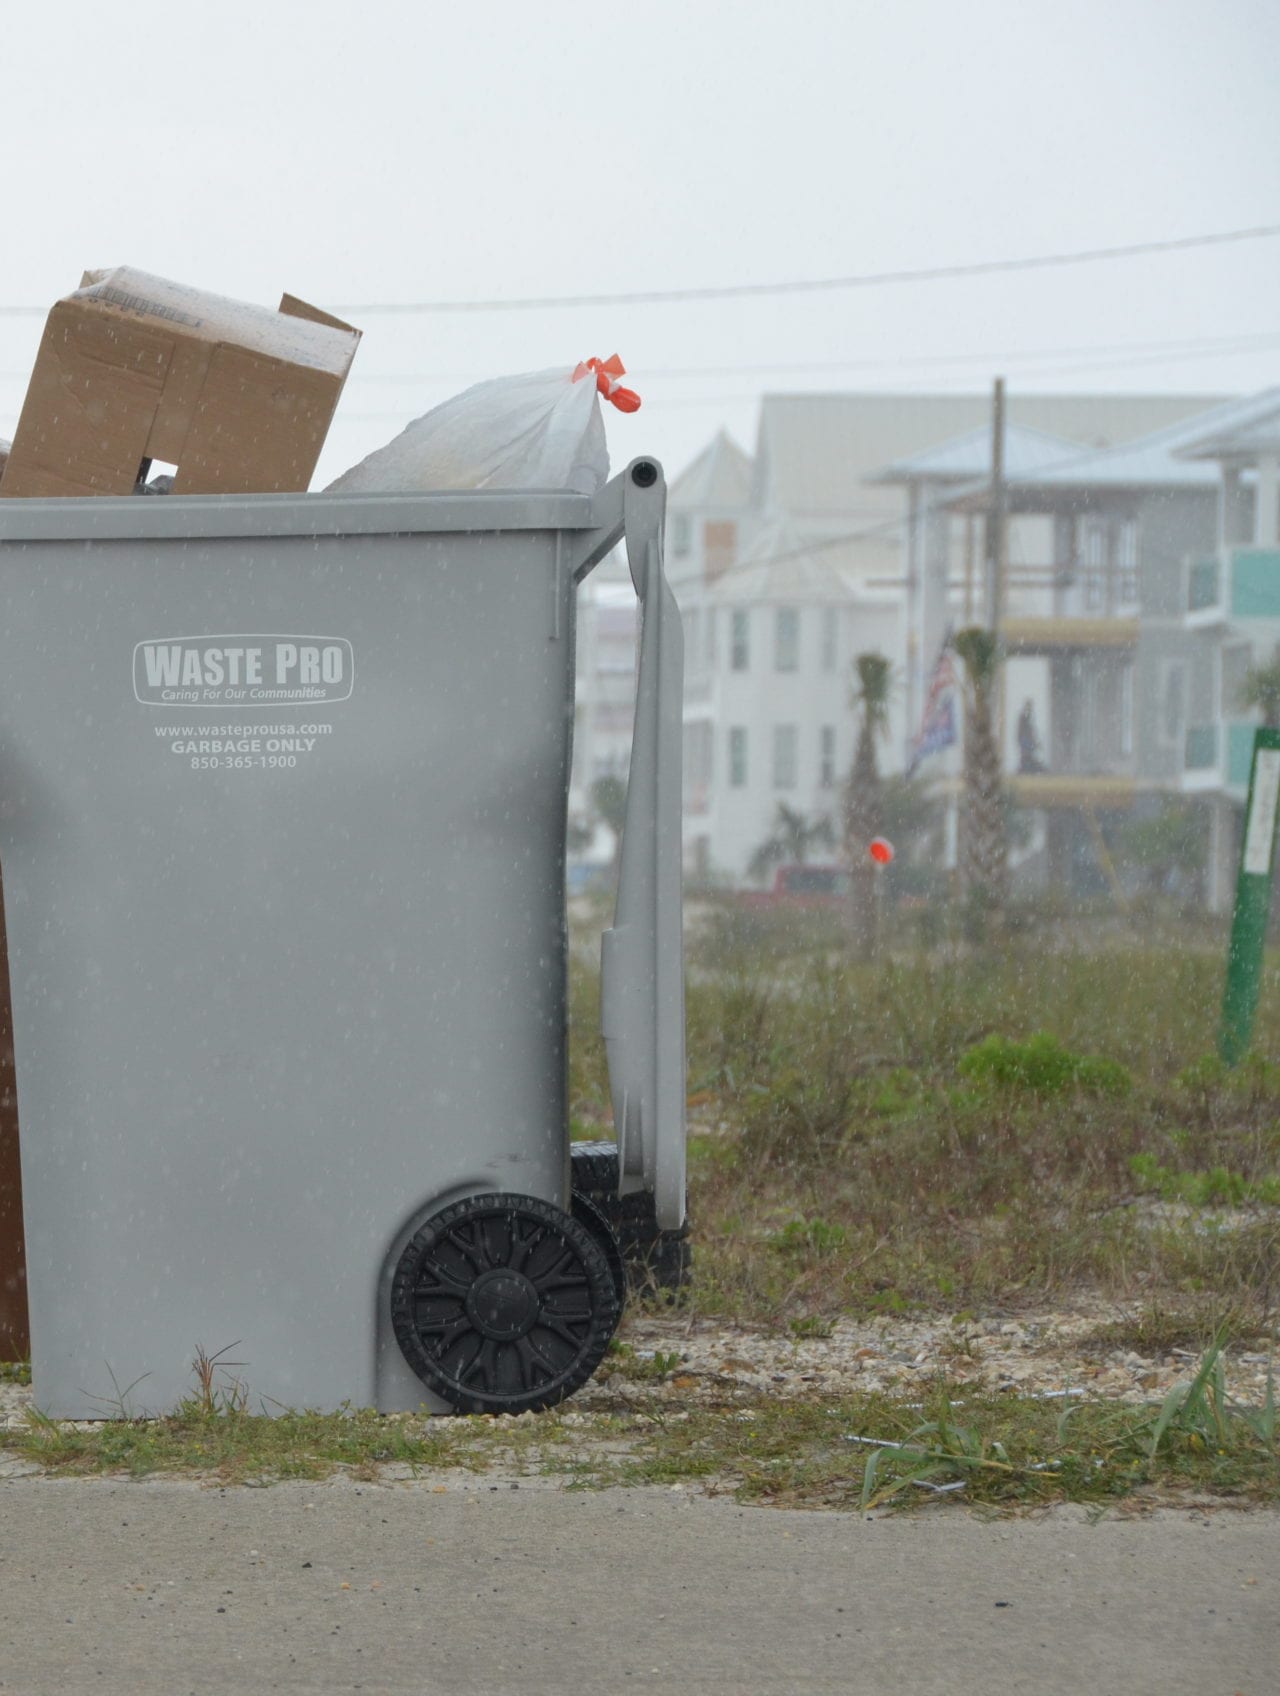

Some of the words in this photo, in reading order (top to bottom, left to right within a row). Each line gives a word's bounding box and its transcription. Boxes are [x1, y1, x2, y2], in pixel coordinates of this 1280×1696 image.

[143, 645, 263, 687] WASTE
[275, 643, 344, 685] PRO
[161, 689, 200, 701] Caring
[203, 688, 222, 700] For
[224, 688, 247, 700] Our
[249, 686, 327, 699] Communities
[154, 722, 333, 738] www.wasteprousa.com
[170, 739, 262, 754] GARBAGE
[266, 738, 317, 753] ONLY
[190, 755, 297, 770] 850-365-1900
